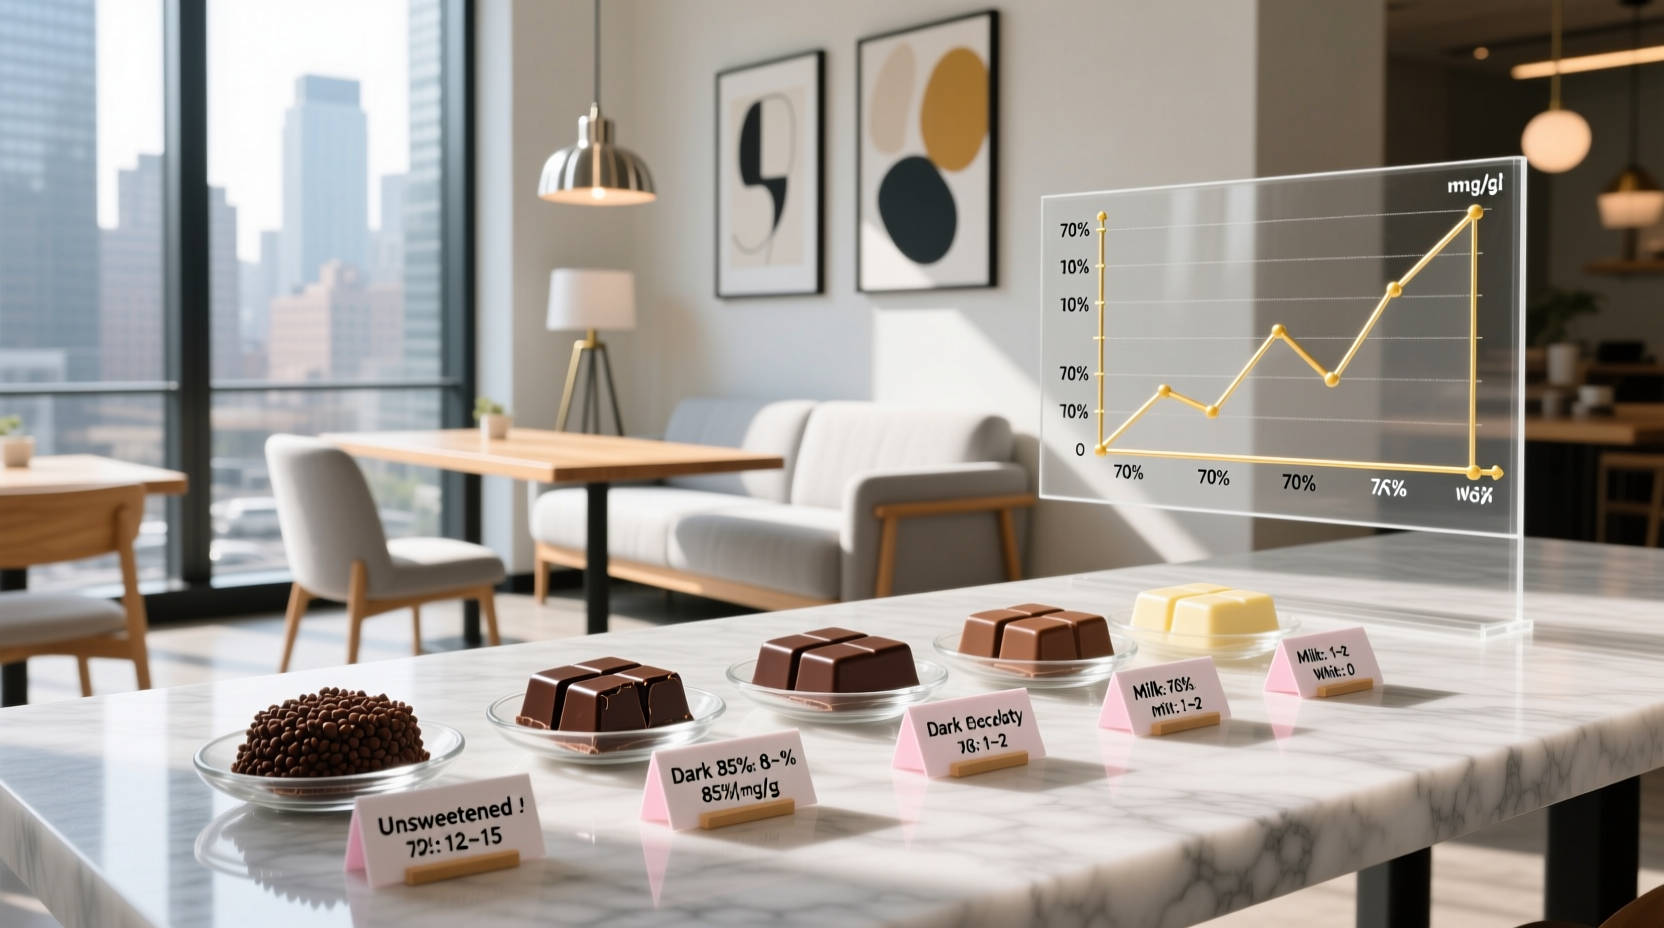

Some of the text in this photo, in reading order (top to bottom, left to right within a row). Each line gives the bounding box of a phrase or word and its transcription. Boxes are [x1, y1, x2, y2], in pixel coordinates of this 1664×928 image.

[1060, 221, 1090, 239] 70%
[1060, 259, 1090, 276] 10%
[1060, 296, 1090, 314] 10%
[1059, 365, 1089, 382] 70%
[1059, 403, 1089, 420] 70%
[1113, 464, 1144, 481] 70%
[1197, 469, 1230, 487] 70%
[1282, 474, 1316, 493] 70%
[926, 716, 963, 738] Dark
[671, 762, 713, 784] Dark
[378, 796, 513, 836] Unsweetened
